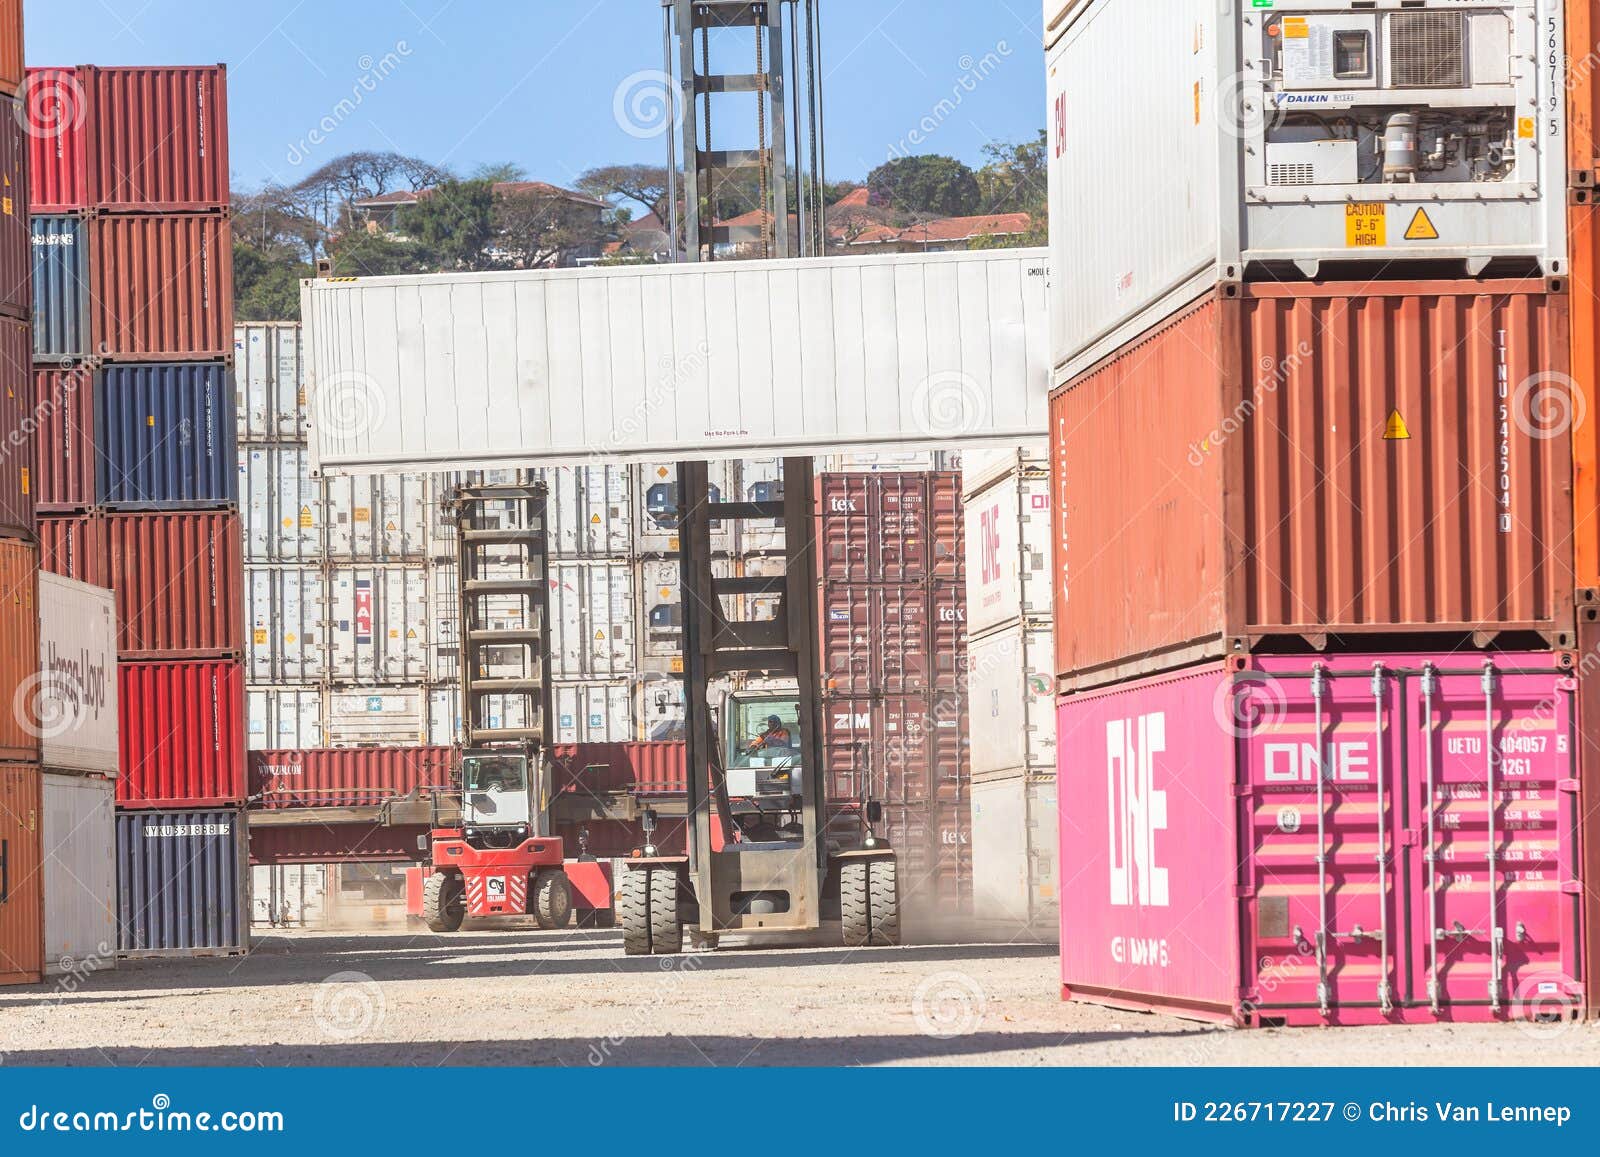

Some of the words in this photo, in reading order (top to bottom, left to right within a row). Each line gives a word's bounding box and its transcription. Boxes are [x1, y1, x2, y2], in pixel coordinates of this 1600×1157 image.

[1287, 95, 1329, 103] DAIKIN
[1346, 203, 1385, 216] CAUTION
[1355, 233, 1377, 246] HIGH
[1497, 329, 1508, 399] TTNU
[1499, 404, 1510, 508] 546504
[831, 496, 857, 512] tex
[357, 591, 371, 634] TAL
[939, 606, 965, 621] tex
[834, 712, 871, 729] ZIM
[1448, 737, 1482, 754] UETU
[1263, 742, 1370, 781] ONE
[1500, 758, 1532, 775] 42G1
[1106, 712, 1170, 906] ONE
[942, 829, 968, 844] tex
